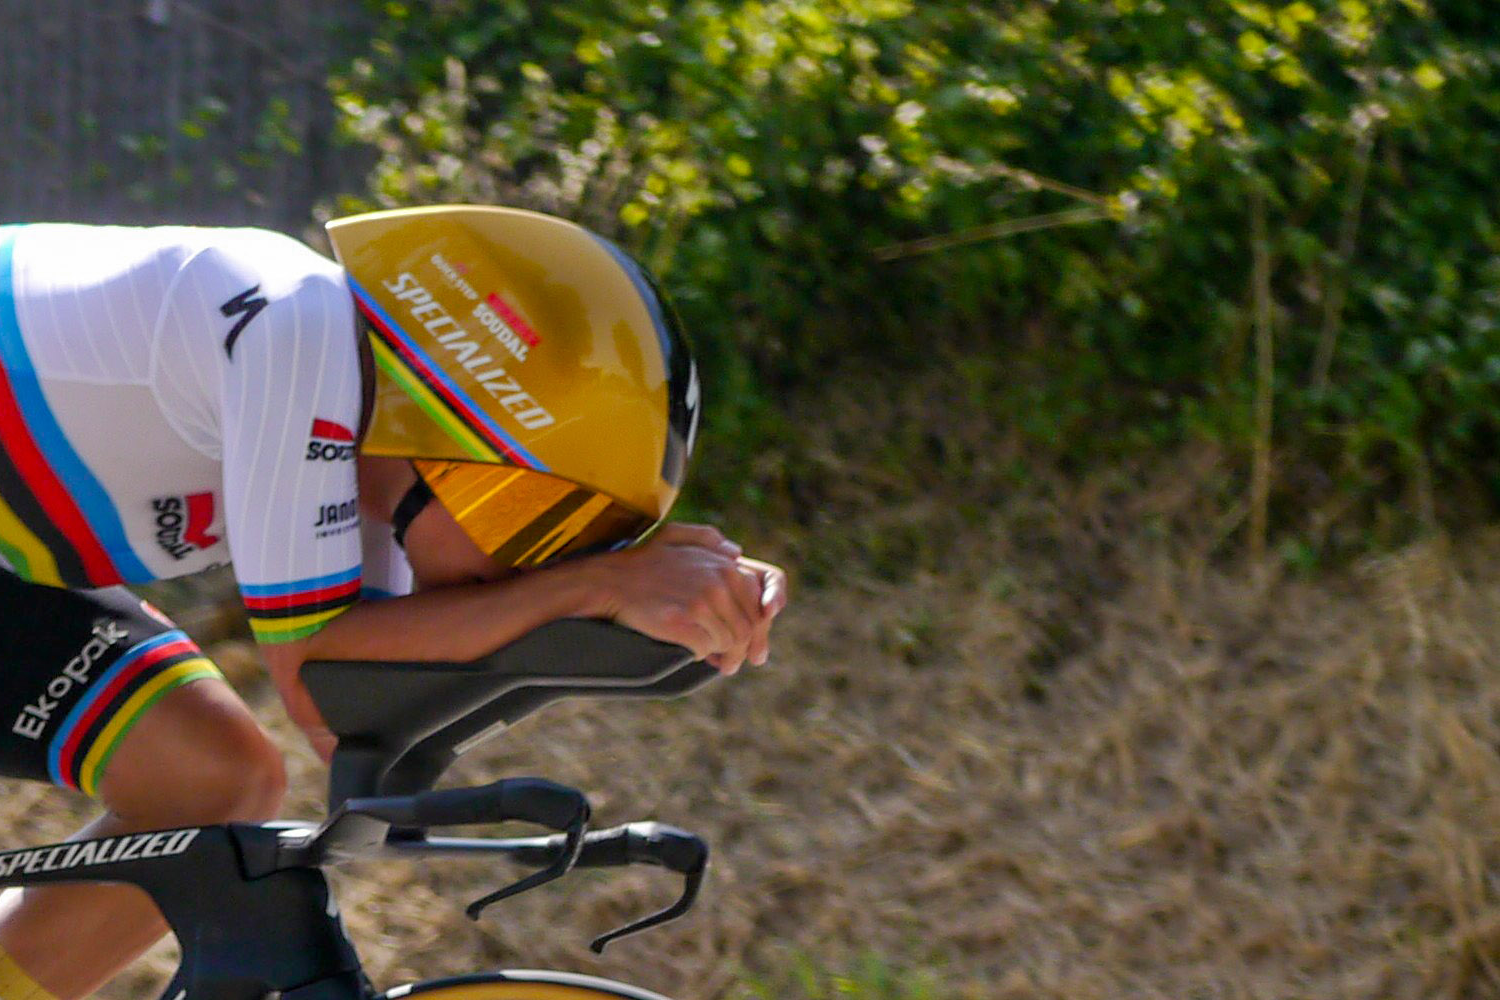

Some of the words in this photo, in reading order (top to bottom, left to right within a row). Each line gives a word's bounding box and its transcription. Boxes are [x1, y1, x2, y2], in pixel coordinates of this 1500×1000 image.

[382, 272, 555, 430] SPECIALIZED
[472, 303, 528, 362] SOUDAL
[12, 620, 129, 740] Ekopak
